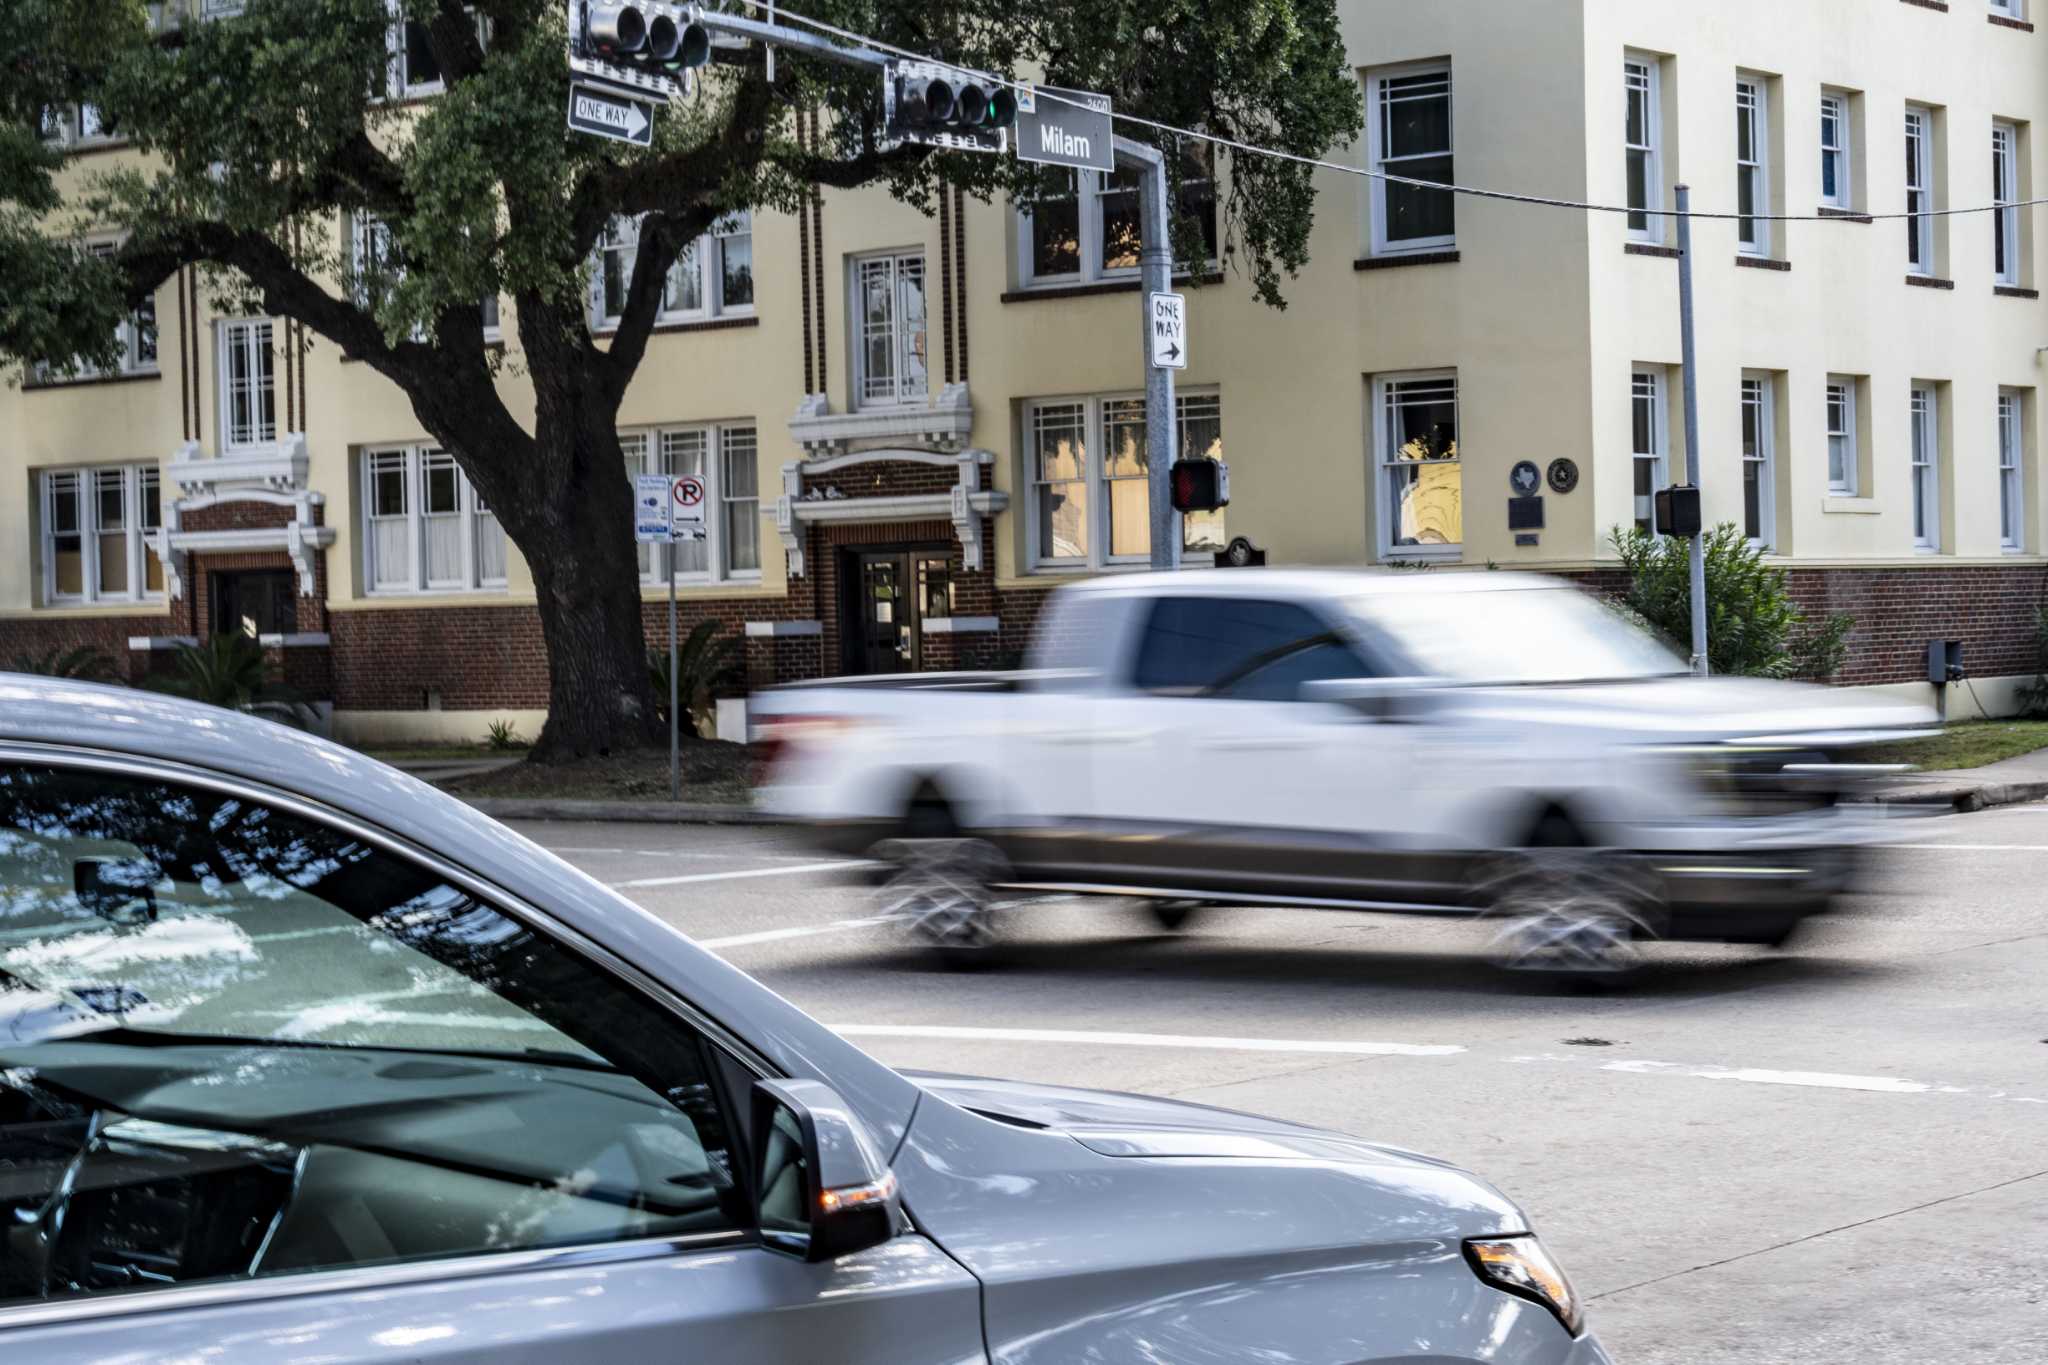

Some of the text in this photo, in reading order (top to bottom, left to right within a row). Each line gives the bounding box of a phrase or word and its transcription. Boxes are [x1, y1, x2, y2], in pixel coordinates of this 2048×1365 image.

[579, 99, 628, 126] ONE WAY
[1041, 123, 1090, 158] Milam
[1156, 300, 1178, 320] ONE
[1156, 320, 1181, 337] WAY
